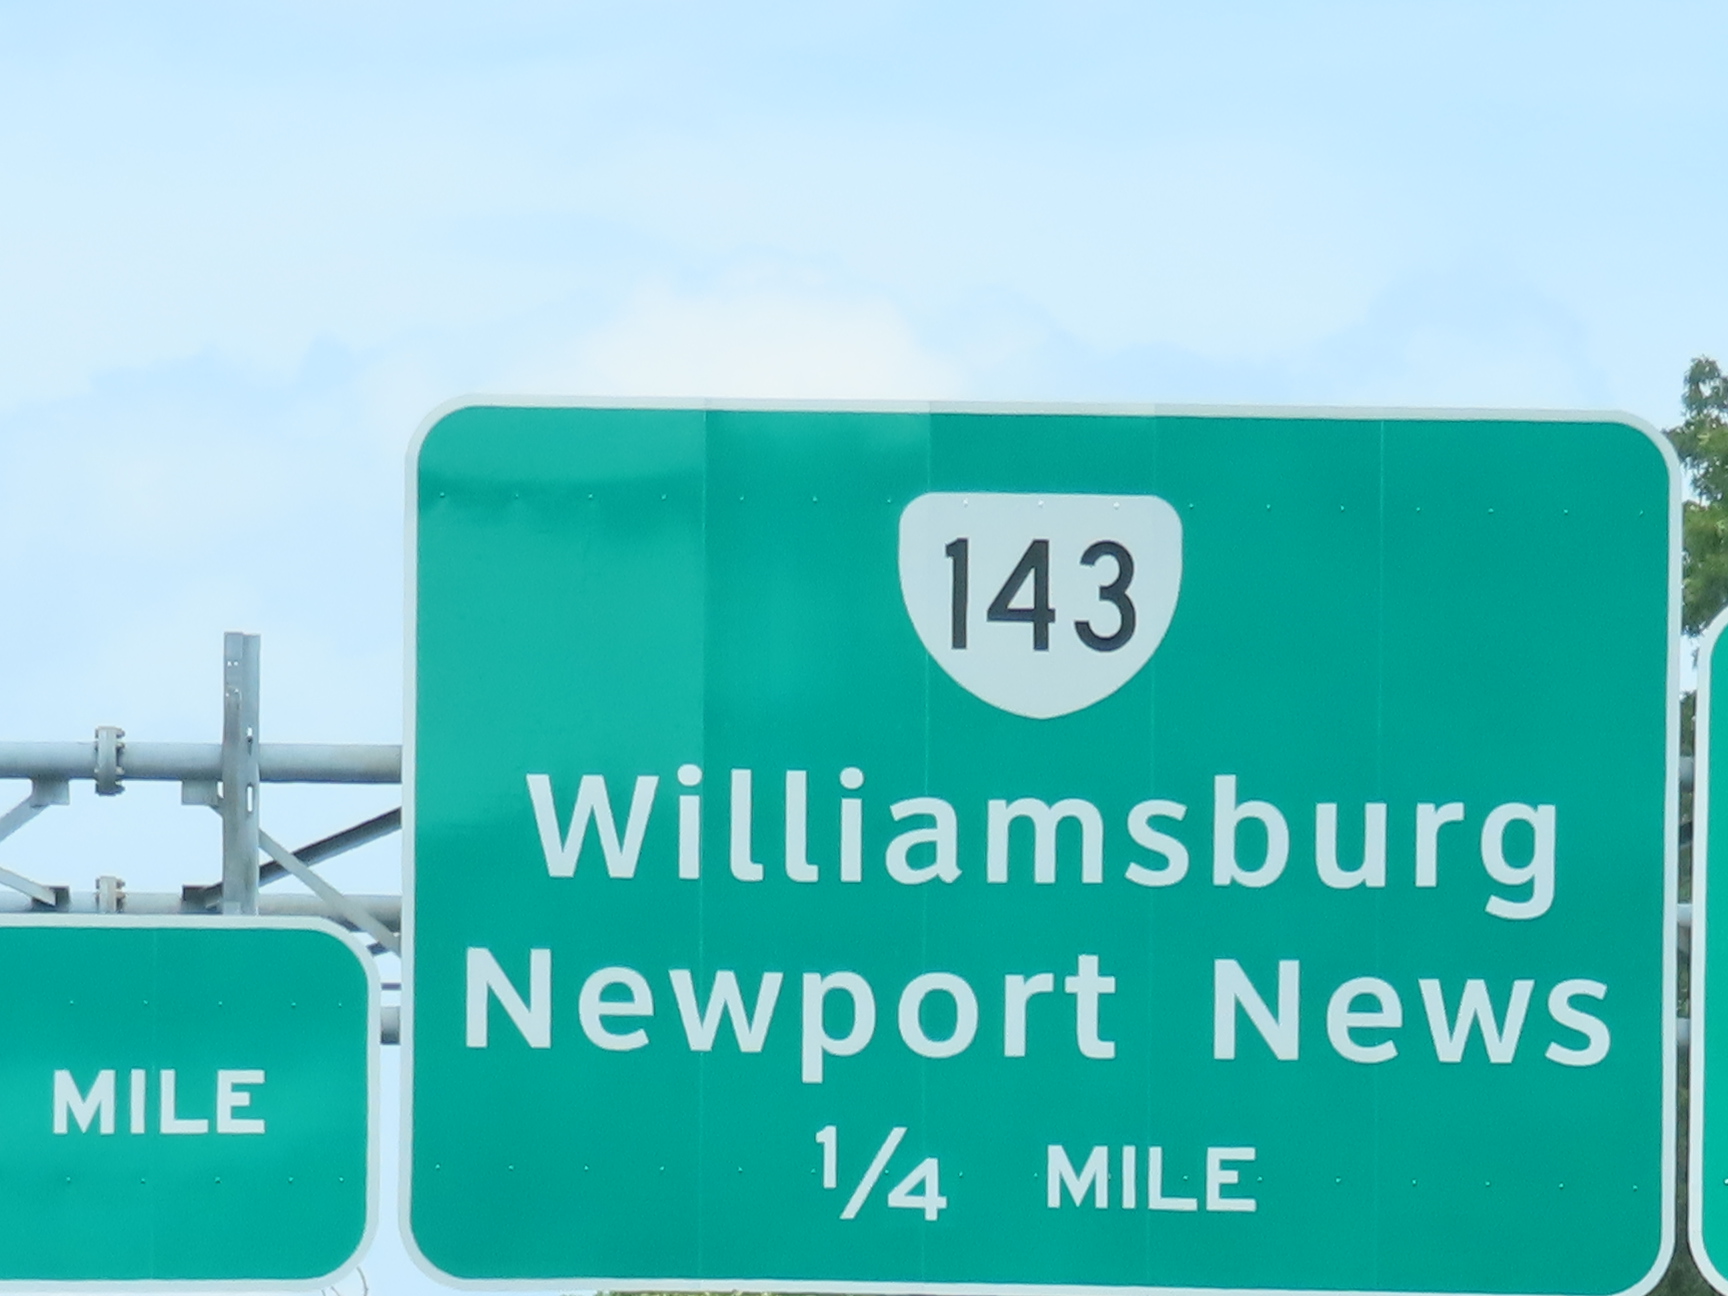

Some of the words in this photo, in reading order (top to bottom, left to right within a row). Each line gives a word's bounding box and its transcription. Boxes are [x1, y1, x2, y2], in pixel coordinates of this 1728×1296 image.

[945, 537, 1137, 652] 143
[526, 764, 1556, 919] Williamsburg
[466, 947, 1116, 1083] Newport
[1214, 959, 1610, 1066] News
[53, 1069, 266, 1134] MILE
[815, 1125, 947, 1221] 1/4
[1046, 1145, 1256, 1212] MILE
